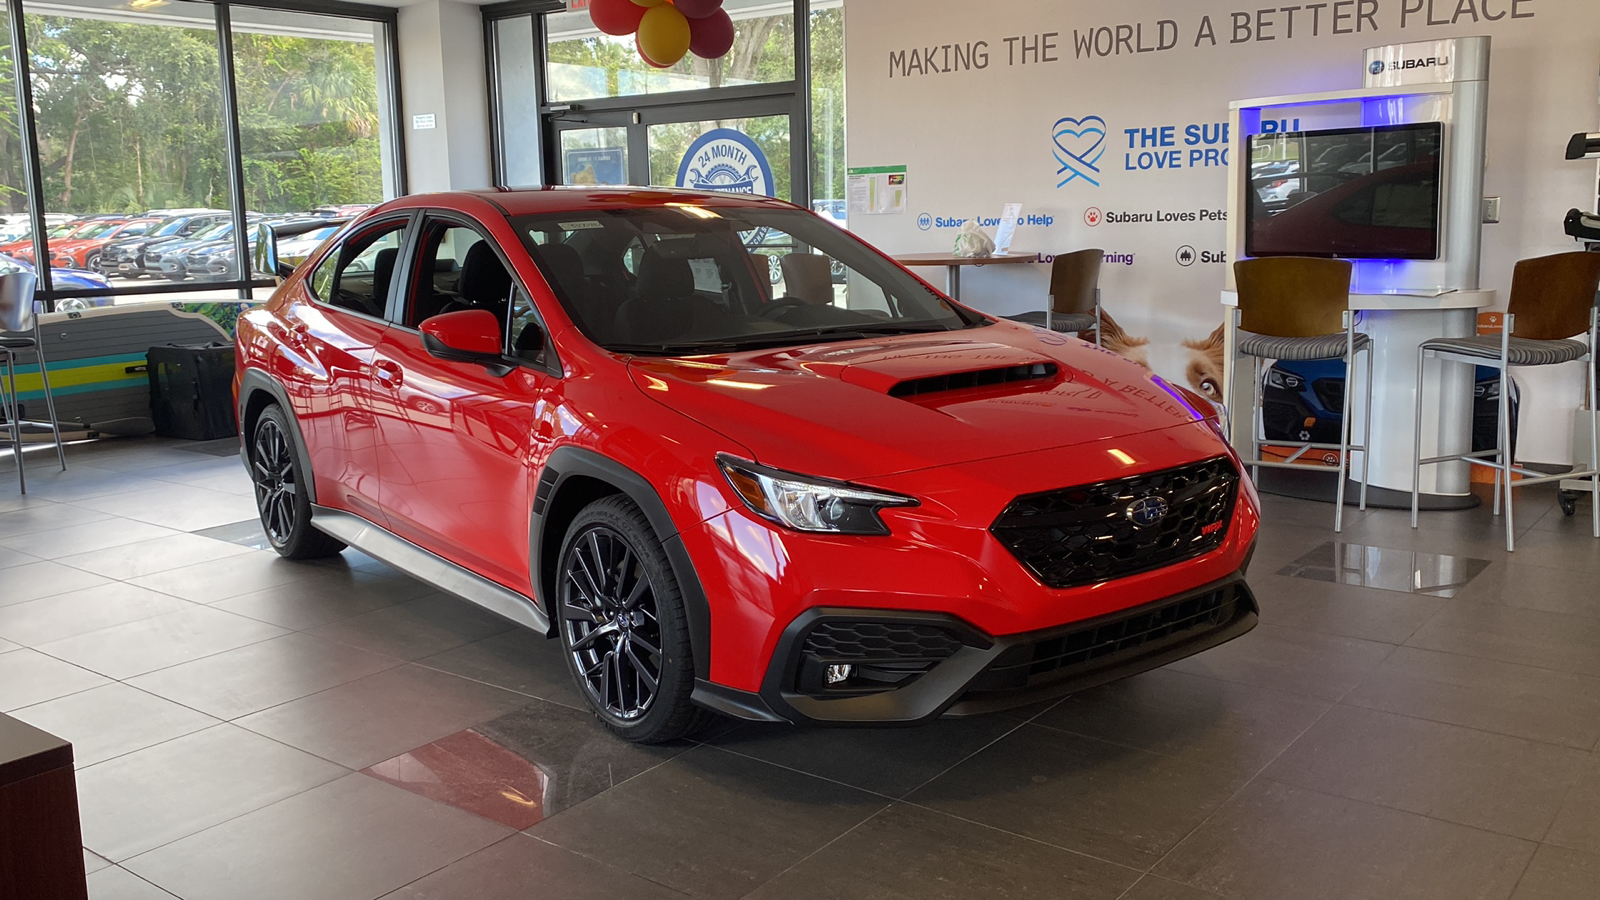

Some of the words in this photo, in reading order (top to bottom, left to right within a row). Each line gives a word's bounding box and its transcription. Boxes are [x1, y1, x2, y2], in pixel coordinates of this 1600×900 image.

[889, 40, 989, 78] MAKING
[1003, 32, 1058, 66] THE
[1073, 19, 1179, 60] WORLD
[1194, 15, 1217, 47] A
[1230, 0, 1379, 44] BETTER
[1387, 56, 1449, 71] SUBARU
[1124, 126, 1176, 148] THE
[698, 150, 711, 168] 24
[711, 144, 747, 165] MONTH
[1125, 150, 1182, 170] LOVE
[977, 216, 1001, 227] Love
[1027, 214, 1054, 227] Help
[1106, 211, 1153, 223] Subaru
[1156, 210, 1196, 222] Loves
